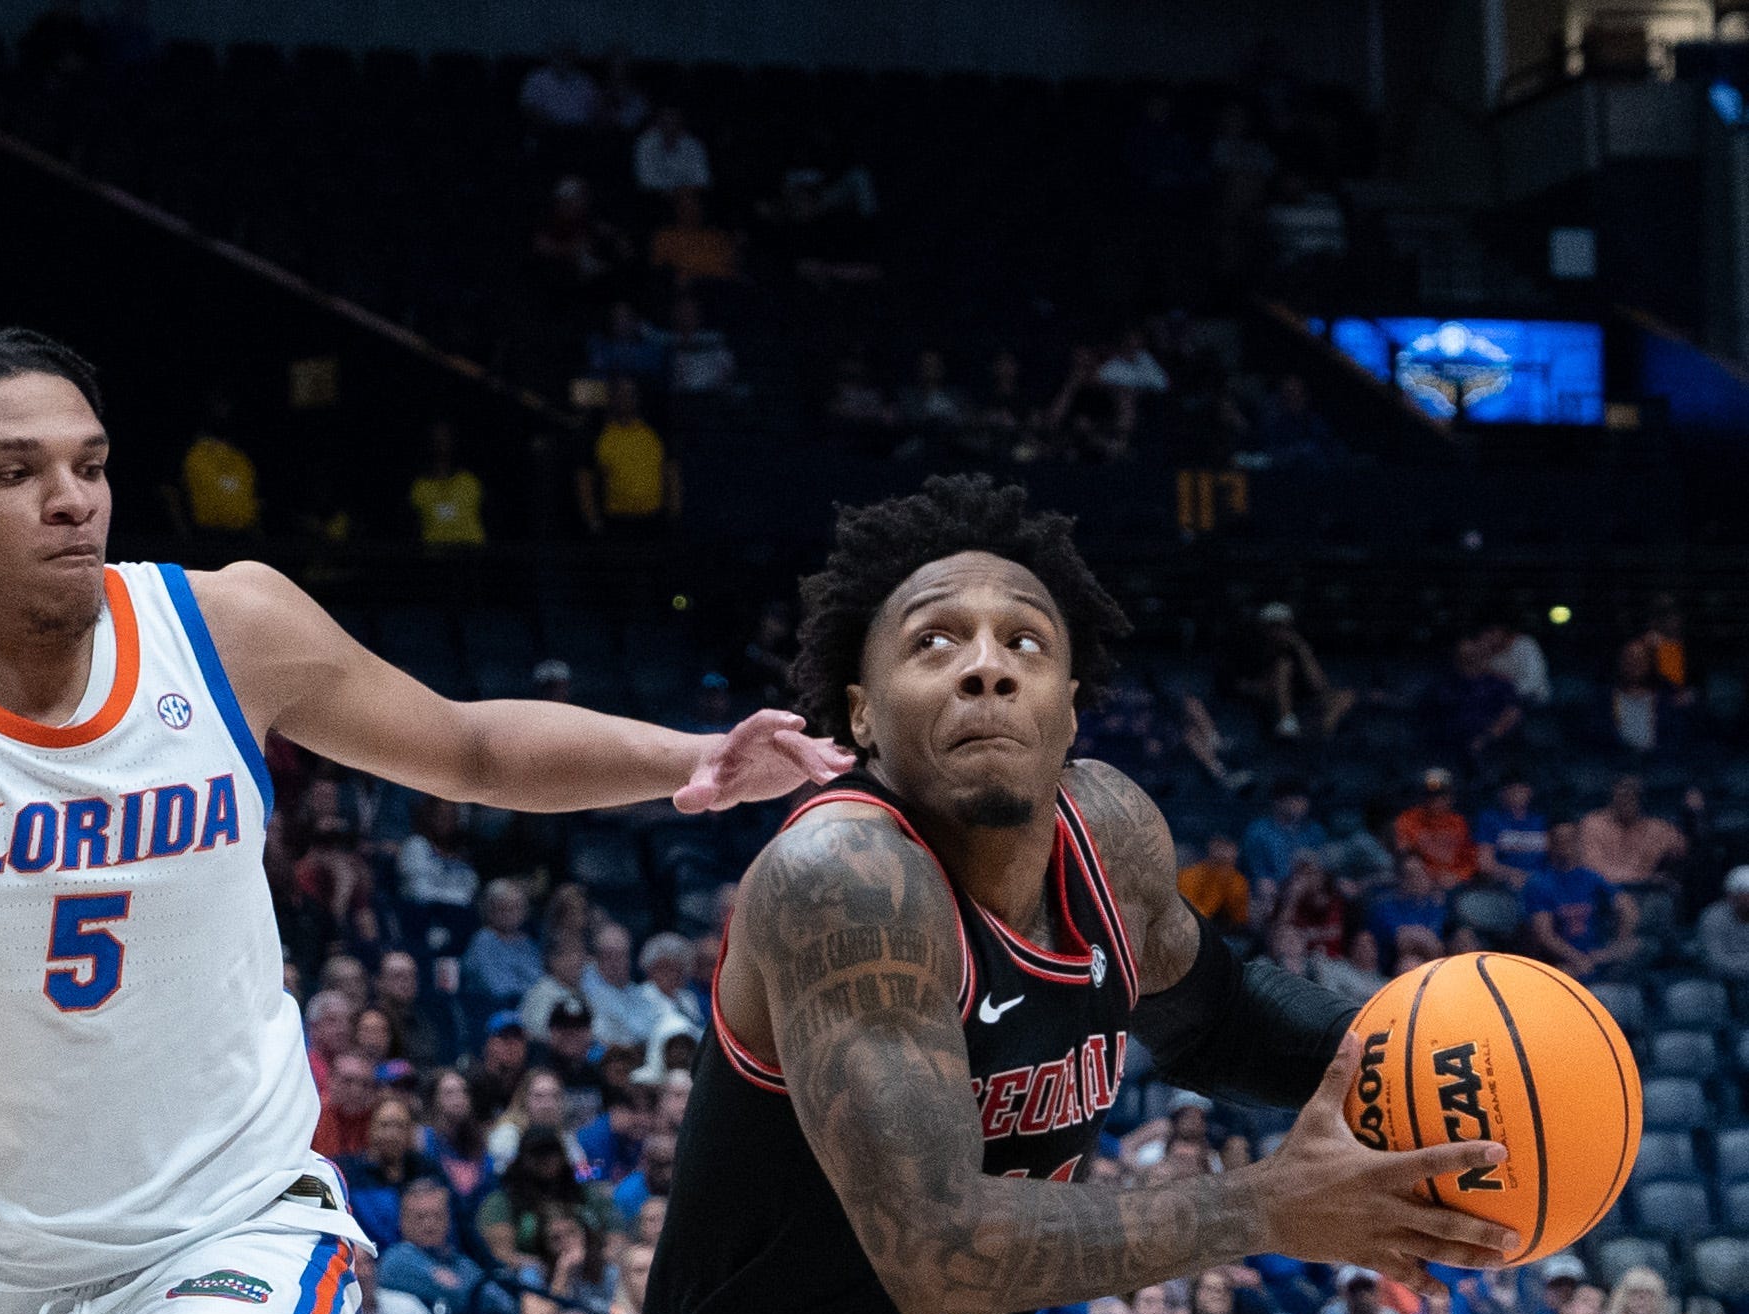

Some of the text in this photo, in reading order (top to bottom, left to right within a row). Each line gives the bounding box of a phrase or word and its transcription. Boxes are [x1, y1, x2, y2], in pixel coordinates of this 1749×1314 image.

[159, 696, 191, 728] SEC
[43, 891, 132, 1013] 5
[1357, 1028, 1393, 1150] lson
[1488, 1080, 1504, 1125] GAME
